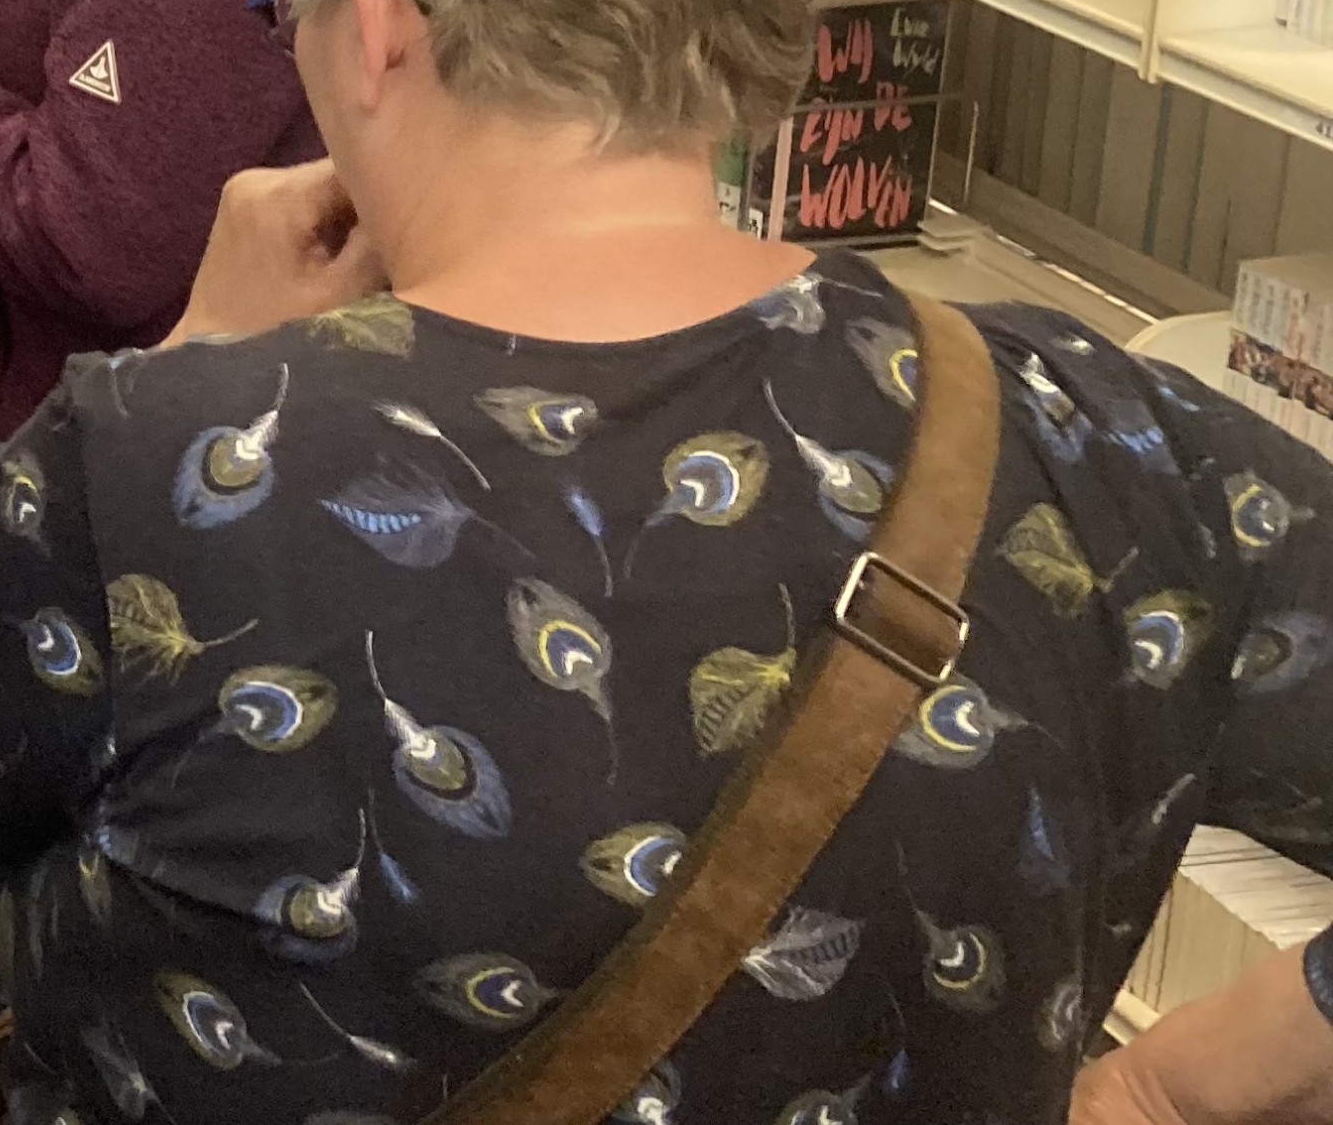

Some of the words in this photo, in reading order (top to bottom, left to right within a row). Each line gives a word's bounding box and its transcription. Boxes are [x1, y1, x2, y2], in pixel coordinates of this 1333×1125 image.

[817, 17, 875, 83] WIJ
[874, 81, 913, 131] DE
[800, 153, 913, 229] WOLVEN
